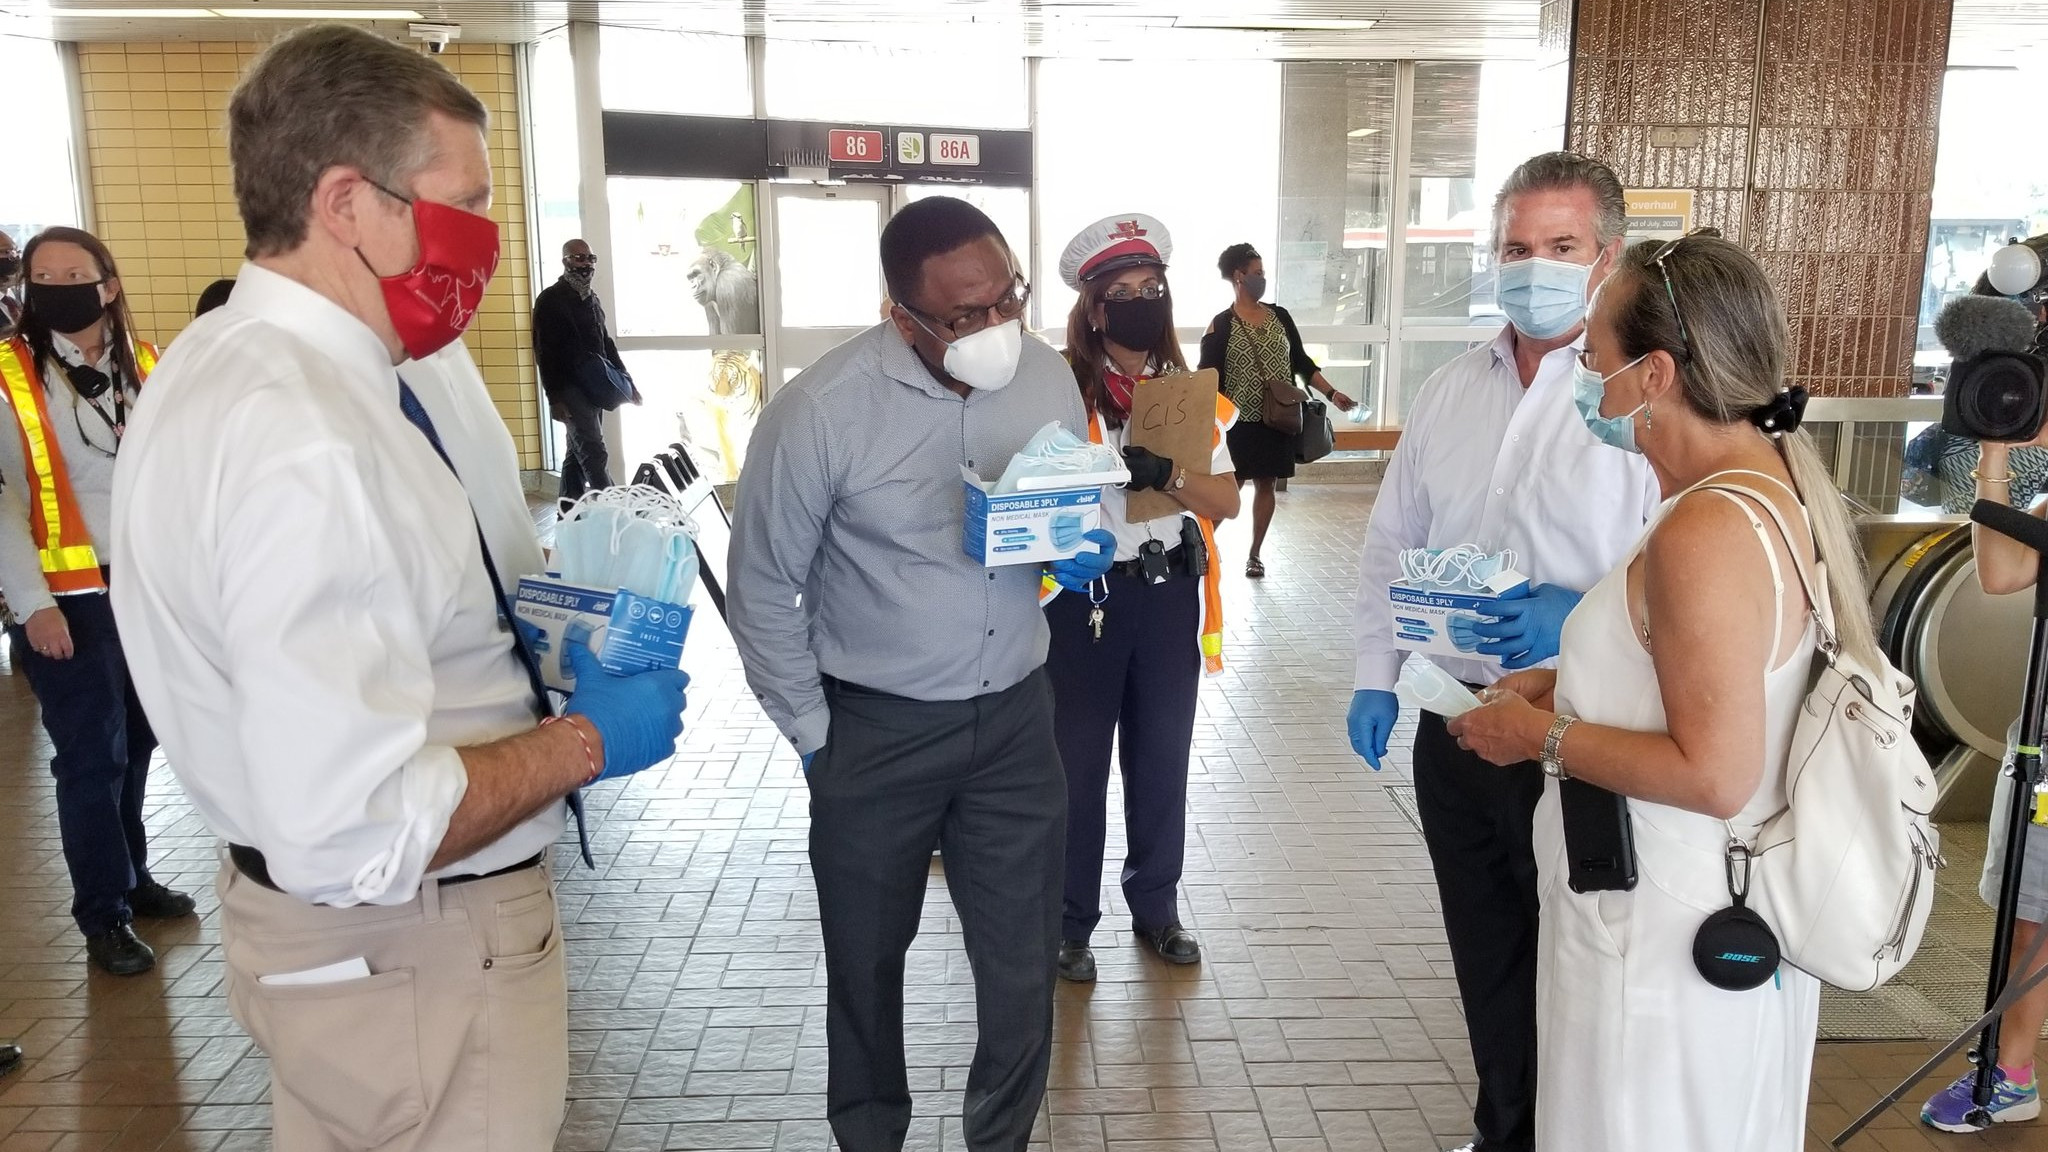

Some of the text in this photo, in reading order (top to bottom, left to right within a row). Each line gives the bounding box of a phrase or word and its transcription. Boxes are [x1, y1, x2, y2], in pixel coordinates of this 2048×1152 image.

[846, 136, 867, 156] 86
[940, 140, 970, 159] 86A
[1631, 200, 1677, 210] overhaul
[1142, 398, 1187, 431] CIS
[991, 497, 1059, 511] DISPOSABLE 3PLY
[991, 511, 1050, 522] NON MEDICAL MASK
[519, 587, 564, 606] DISPOSABLE
[564, 595, 581, 608] 3PLY
[1391, 592, 1454, 607] DISPOSABLE 3PLY
[518, 606, 568, 621] NON MEDICAL MASK
[1392, 603, 1446, 616] NON MEDICAL MASK
[1721, 952, 1761, 963] BOSE
